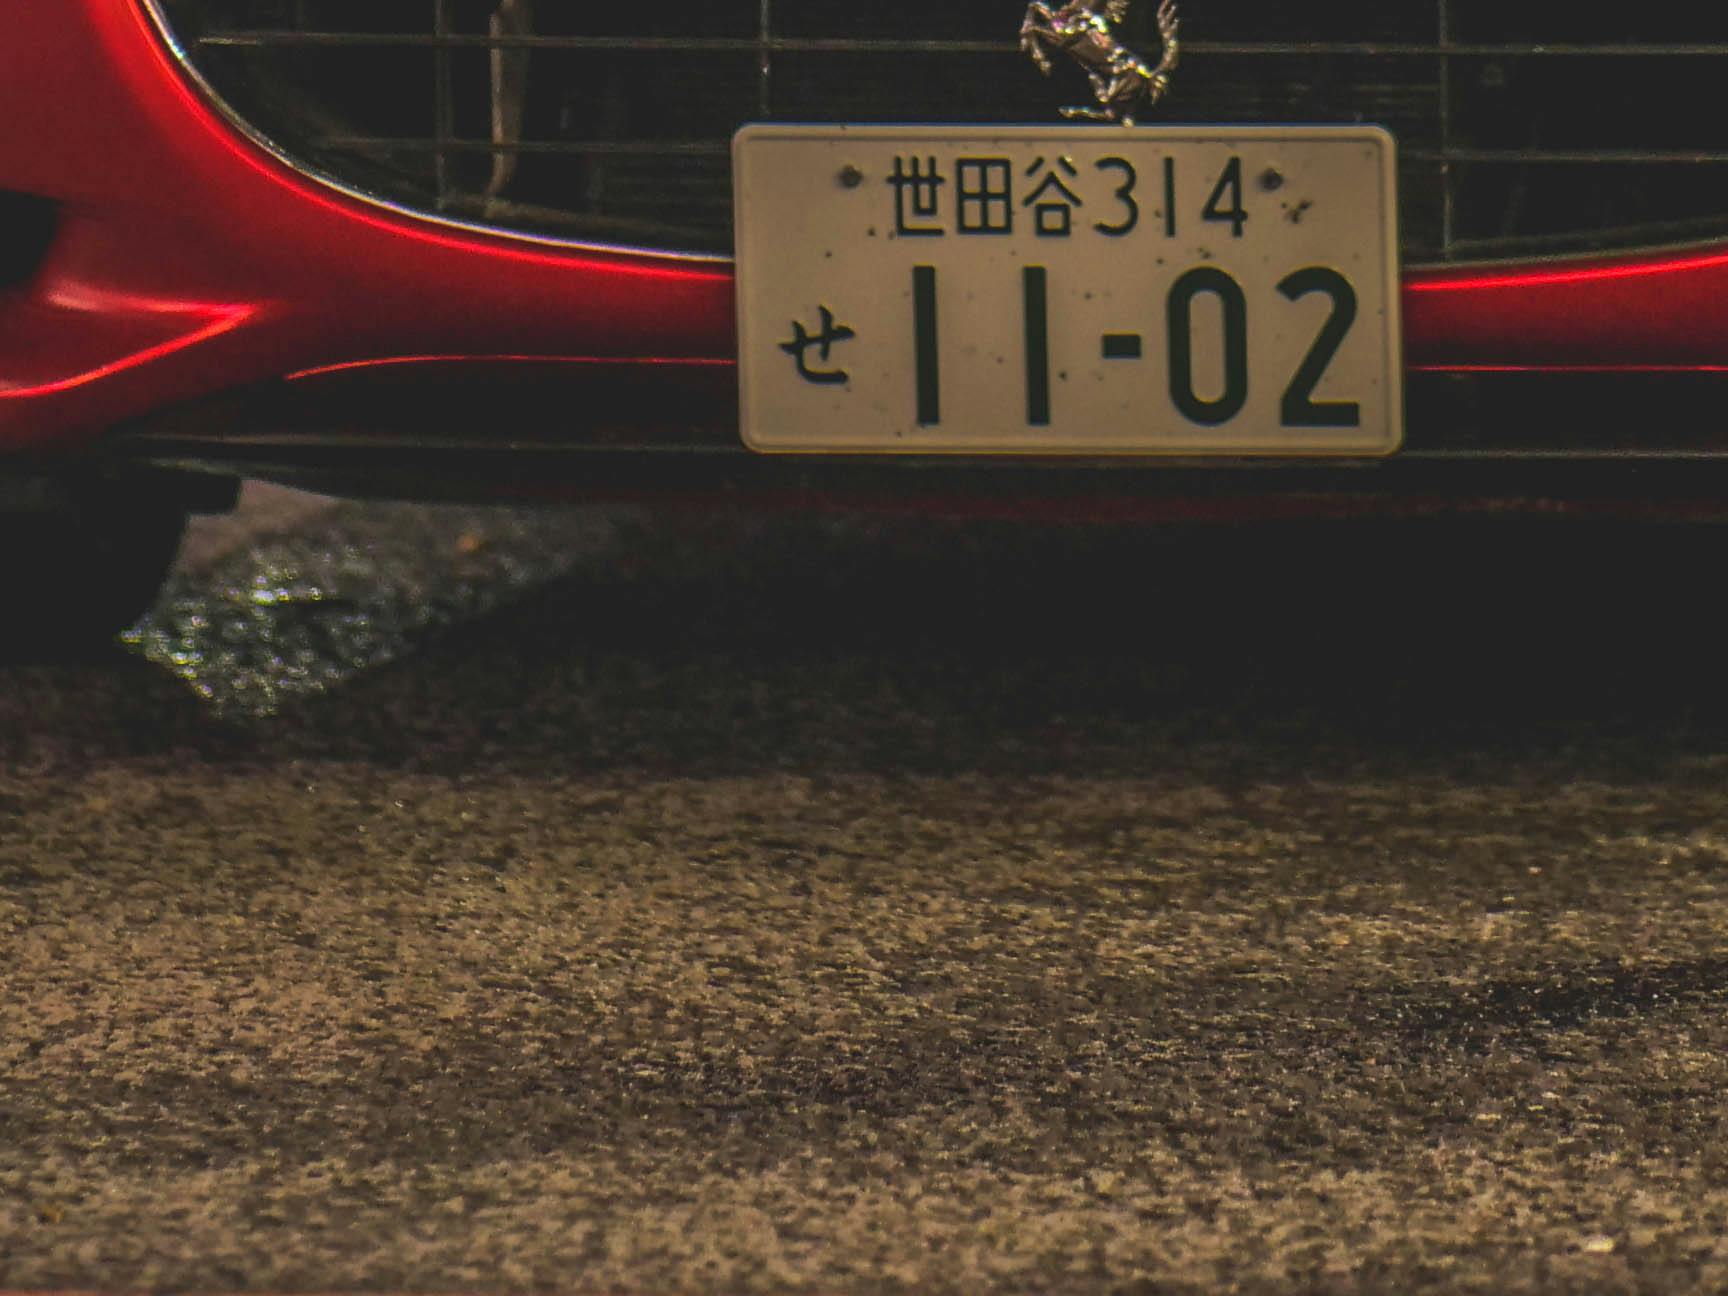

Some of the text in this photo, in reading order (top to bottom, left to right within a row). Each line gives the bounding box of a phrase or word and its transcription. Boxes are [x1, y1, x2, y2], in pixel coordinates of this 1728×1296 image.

[886, 154, 1249, 240] 世田谷314
[778, 264, 1361, 427] せ 11-02
